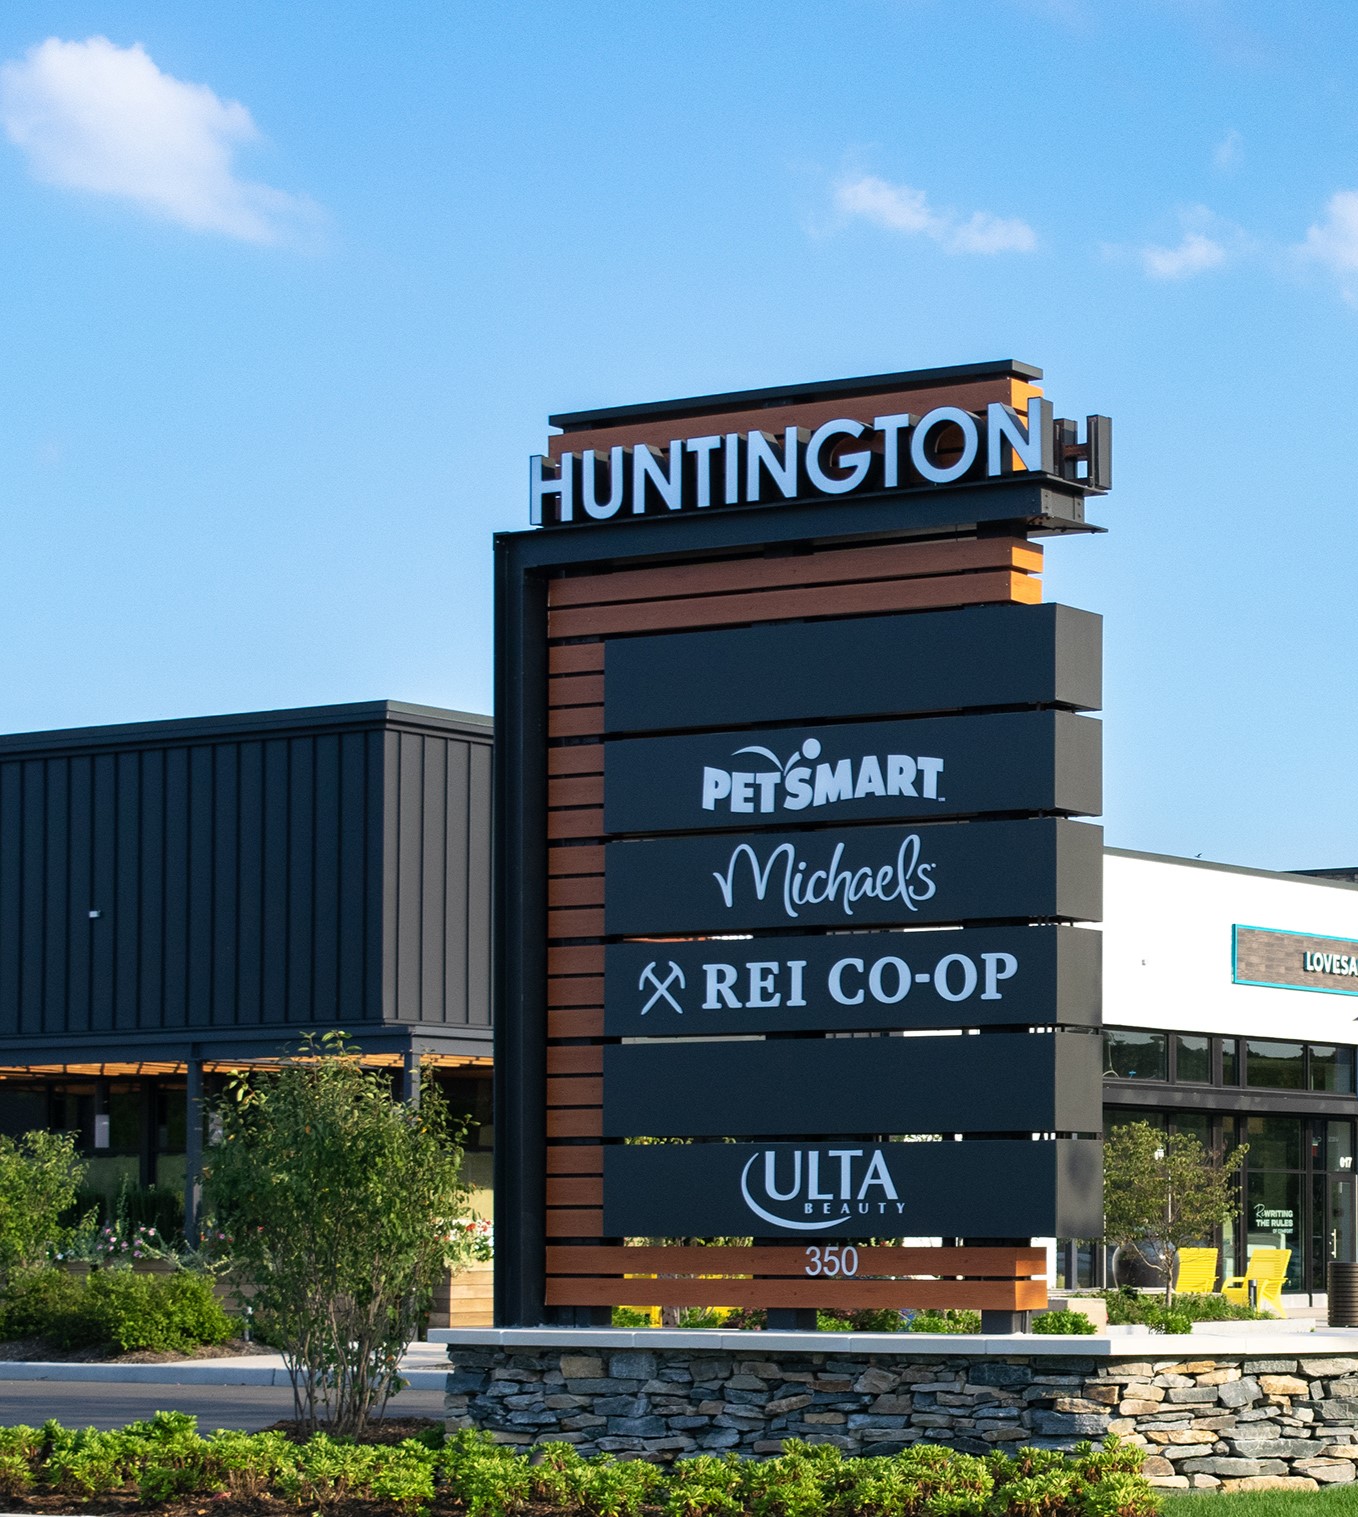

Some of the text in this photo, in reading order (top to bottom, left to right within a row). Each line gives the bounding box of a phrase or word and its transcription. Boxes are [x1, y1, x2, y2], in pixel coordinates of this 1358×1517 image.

[529, 396, 1048, 526] HUNTINGTON
[702, 753, 944, 813] PETSMART
[712, 834, 937, 918] Michaels
[701, 952, 1019, 1010] REI CO-OP
[765, 1149, 900, 1201] ULTA
[804, 1202, 905, 1214] BEAUTY
[1255, 1219, 1293, 1227] THE RULES
[804, 1246, 859, 1276] 350
